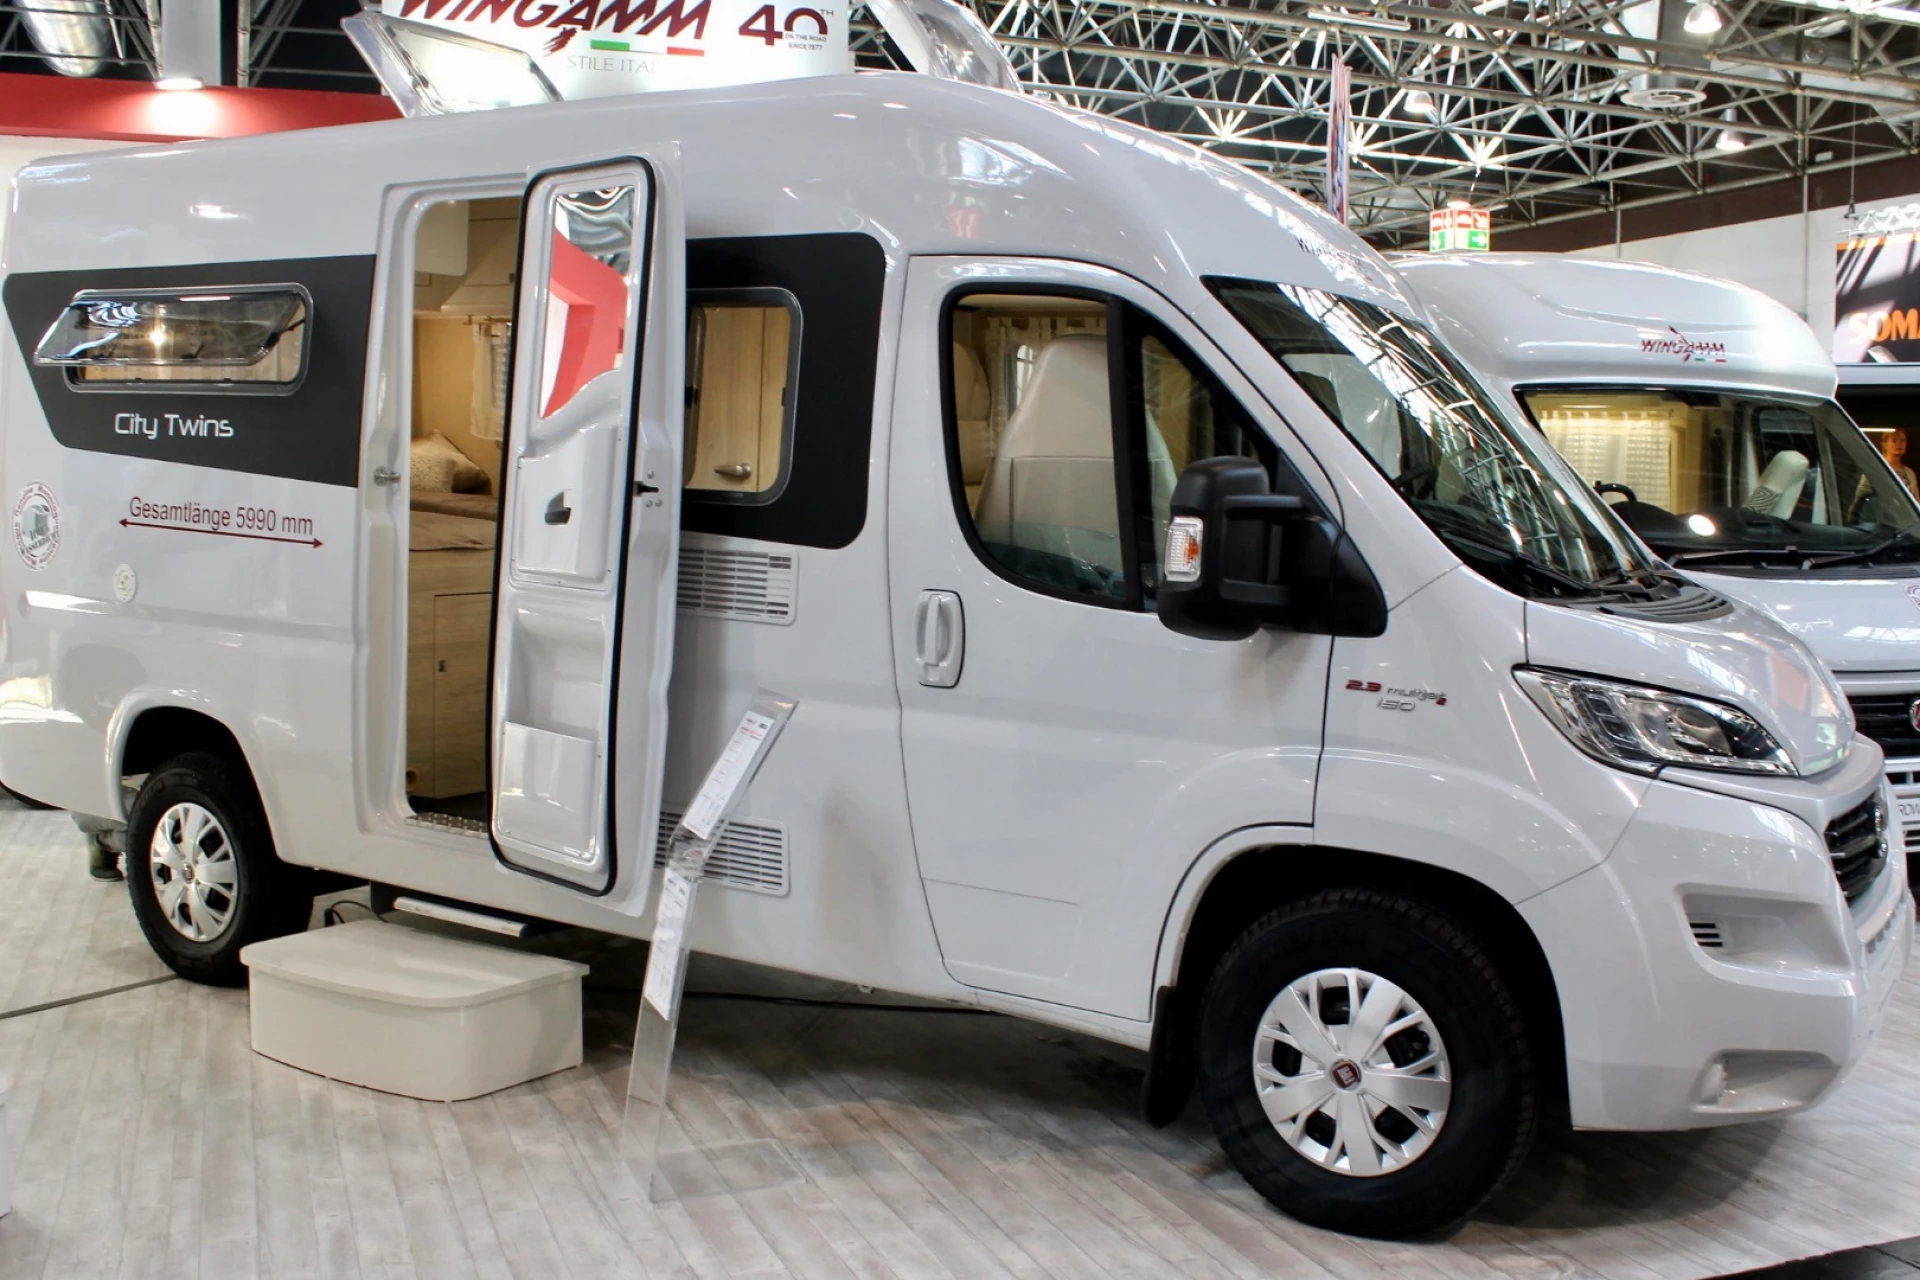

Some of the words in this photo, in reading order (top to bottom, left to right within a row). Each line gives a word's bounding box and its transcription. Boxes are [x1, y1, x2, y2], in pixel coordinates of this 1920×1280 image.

[738, 4, 828, 46] 40
[788, 42, 807, 50] SINCE
[567, 54, 615, 72] STILE
[620, 58, 654, 74] ITA
[1848, 307, 1920, 345] SOM
[114, 413, 157, 440] City
[164, 414, 234, 437] Twins
[129, 496, 231, 531] Gesamtlänge
[236, 506, 276, 531] 5990
[282, 516, 313, 535] mm
[1345, 679, 1382, 693] 2.3
